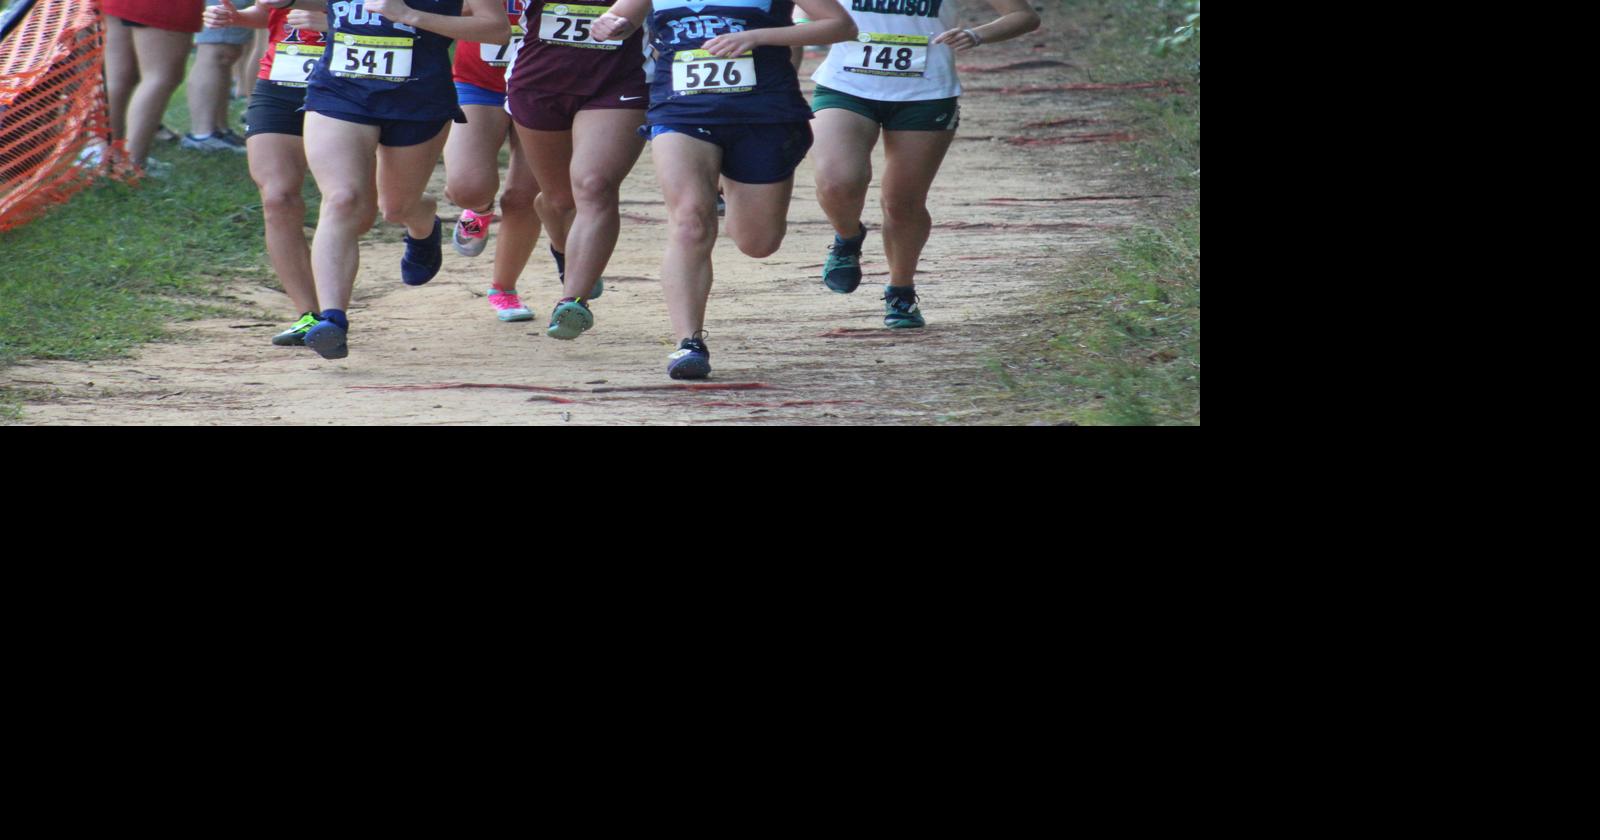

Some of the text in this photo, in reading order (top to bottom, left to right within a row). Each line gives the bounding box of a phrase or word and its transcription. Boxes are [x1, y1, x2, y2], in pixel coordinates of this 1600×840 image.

[552, 17, 605, 42] 25
[345, 48, 394, 75] 541
[861, 45, 913, 70] 148
[686, 61, 742, 88] 526
